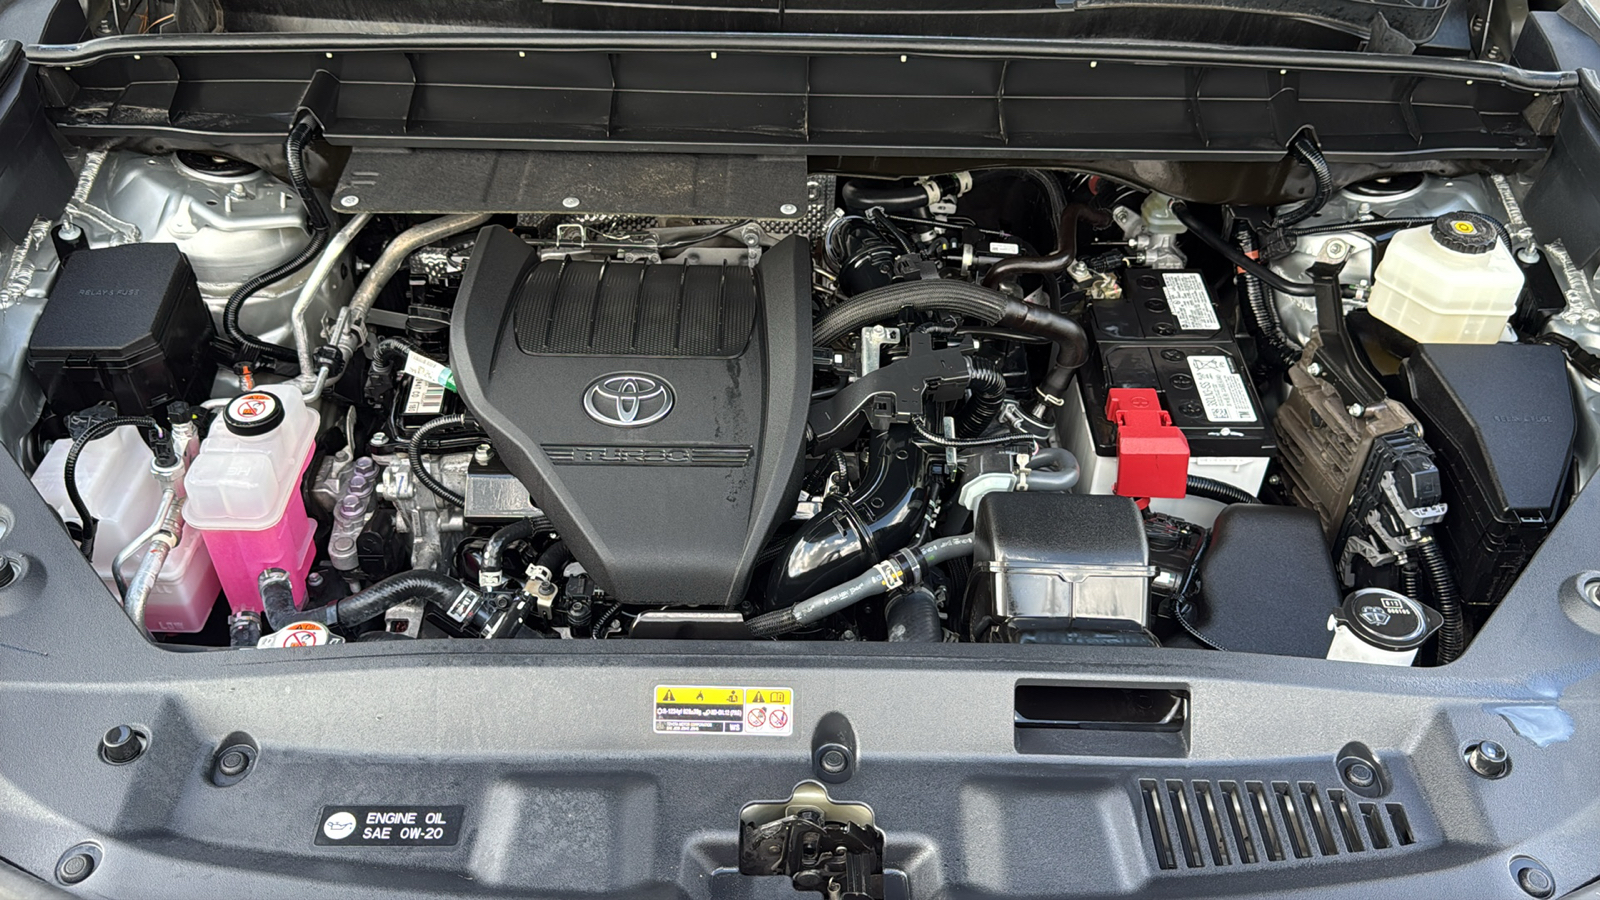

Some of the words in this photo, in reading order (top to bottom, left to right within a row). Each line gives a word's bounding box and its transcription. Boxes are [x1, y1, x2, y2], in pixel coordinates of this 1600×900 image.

[576, 447, 690, 462] TURBO
[158, 621, 185, 630] LOW
[365, 812, 418, 824] ENGINE
[425, 812, 447, 824] OIL
[362, 827, 393, 840] SAE
[399, 827, 444, 840] 0W-20
